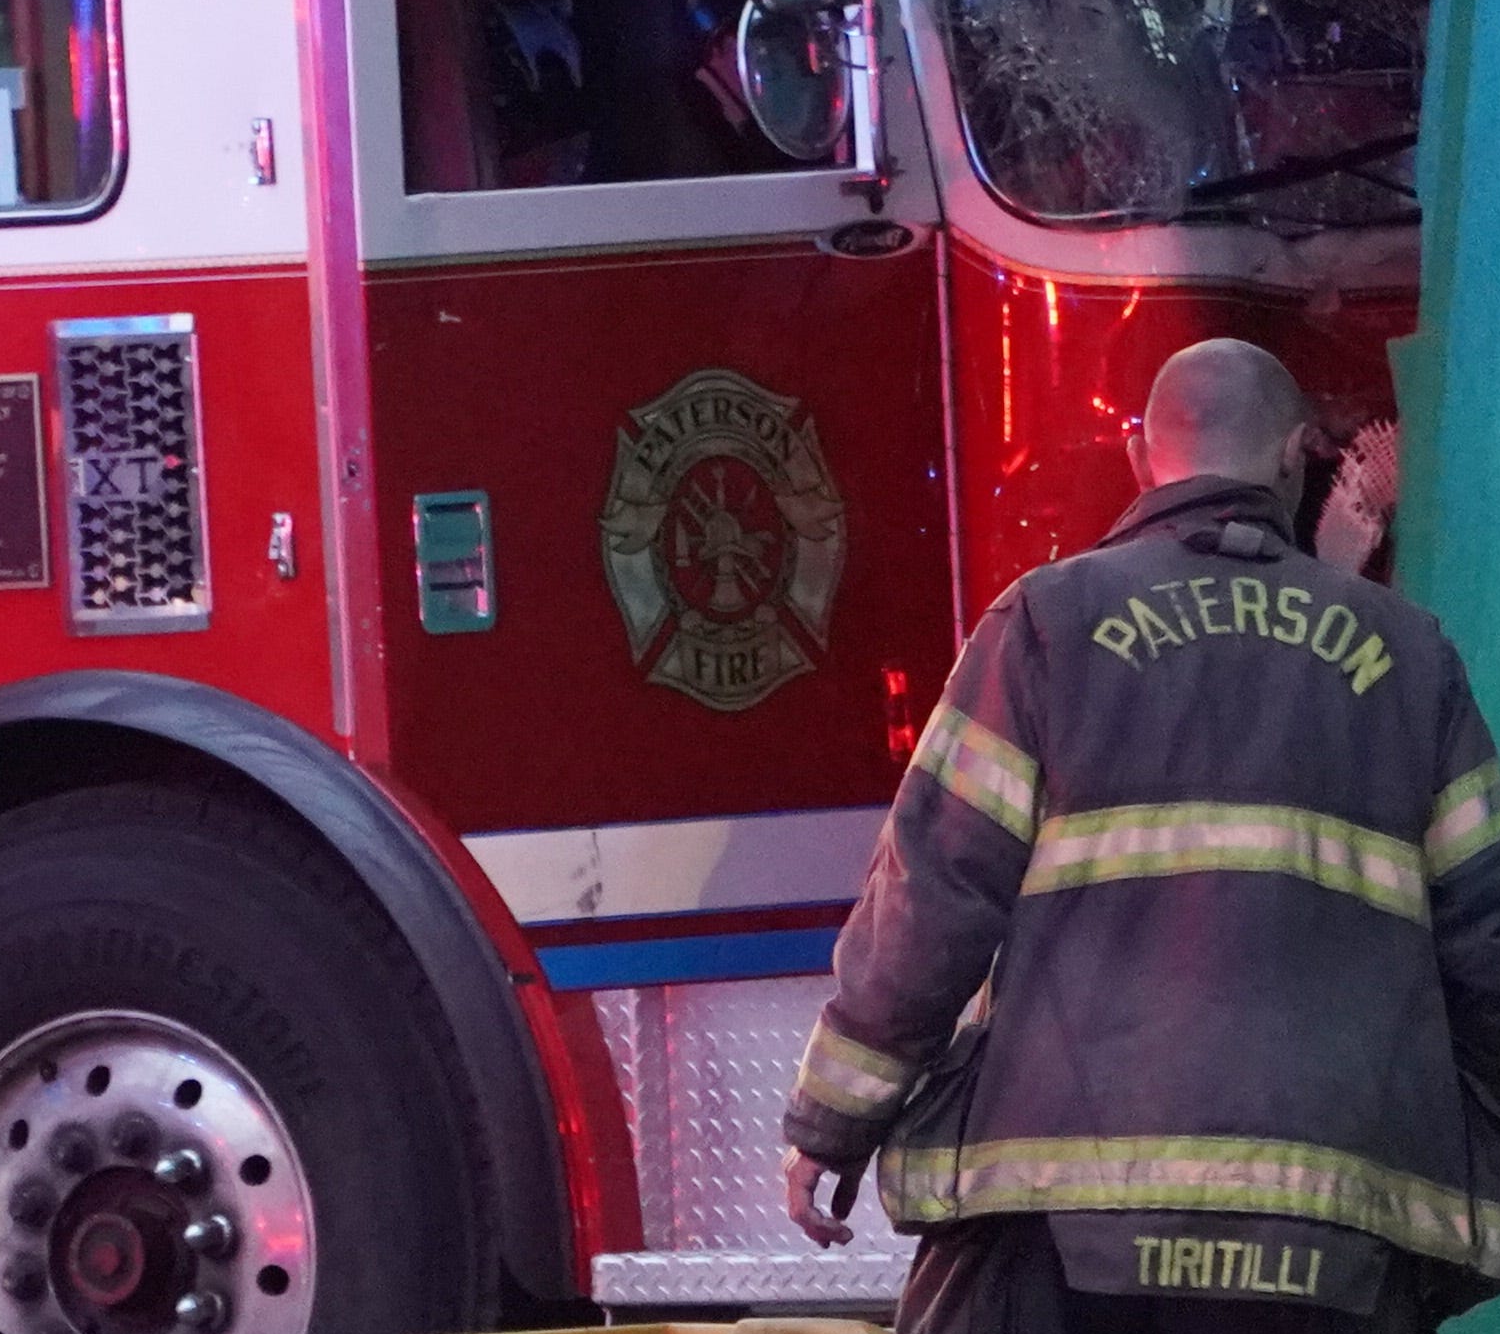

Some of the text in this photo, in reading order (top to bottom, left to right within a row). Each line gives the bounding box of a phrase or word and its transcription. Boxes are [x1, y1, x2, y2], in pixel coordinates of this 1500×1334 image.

[636, 396, 797, 473] PATERSON
[693, 645, 769, 687] FIRE
[1092, 576, 1394, 696] PATERSON
